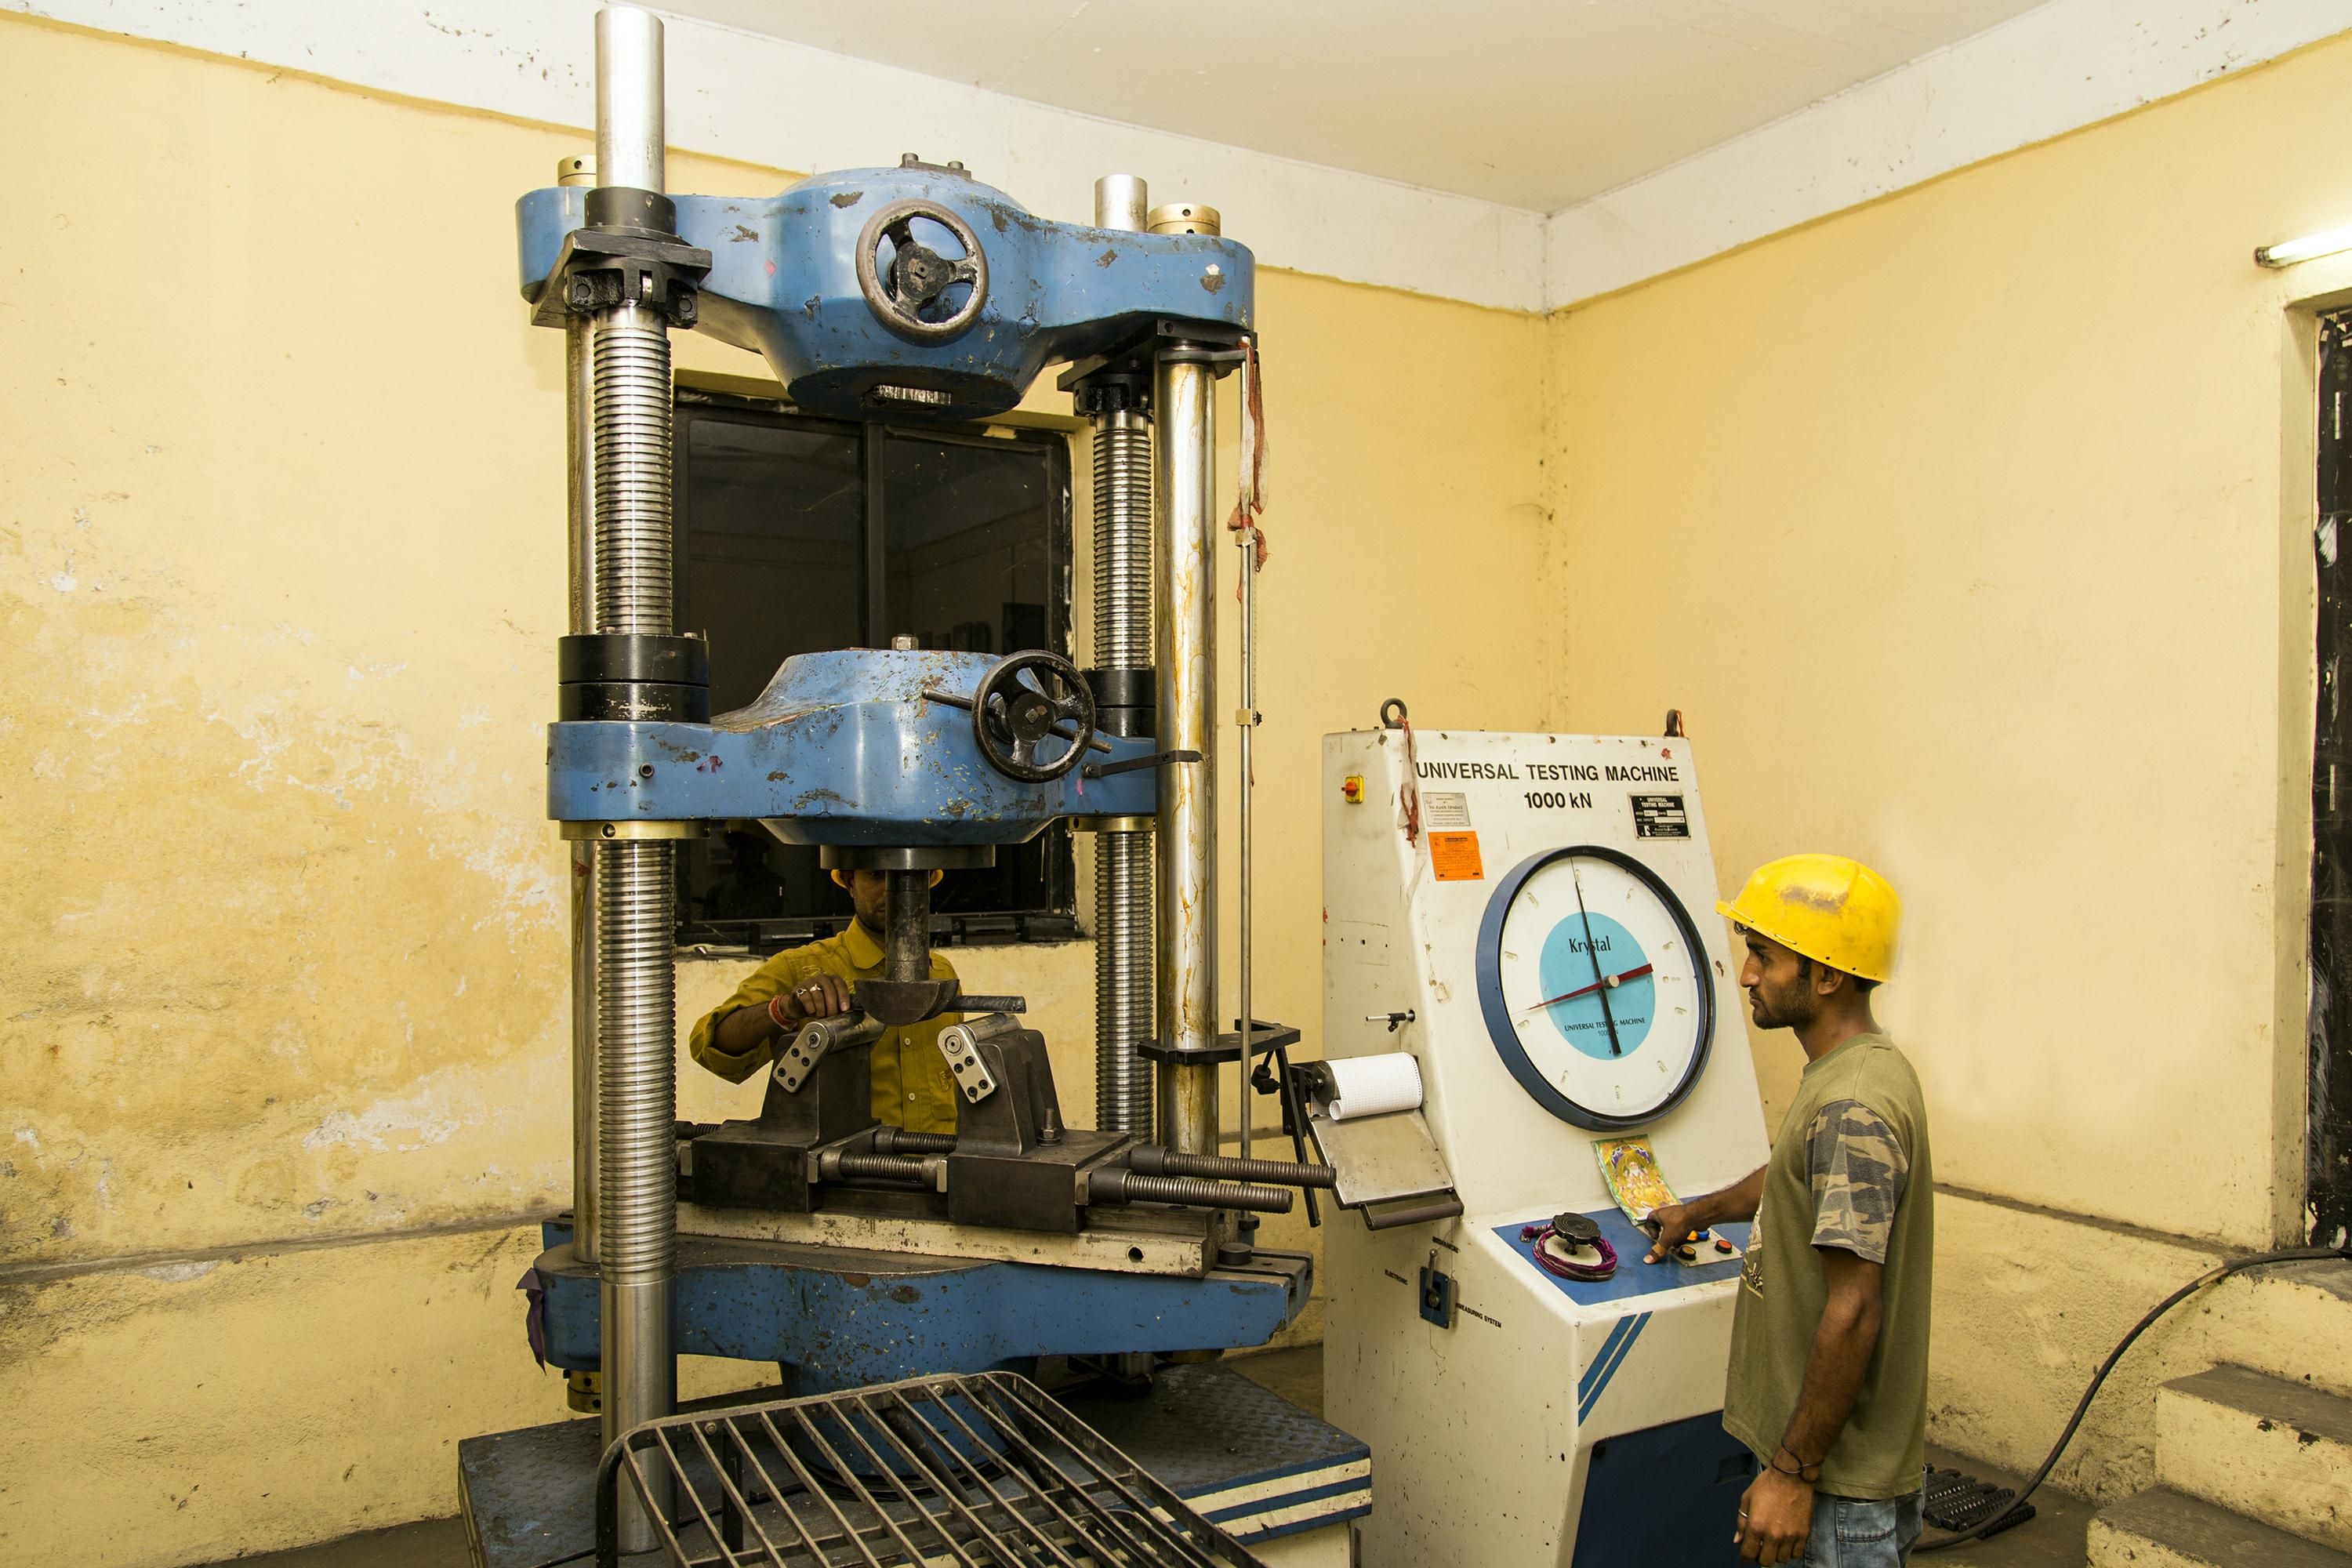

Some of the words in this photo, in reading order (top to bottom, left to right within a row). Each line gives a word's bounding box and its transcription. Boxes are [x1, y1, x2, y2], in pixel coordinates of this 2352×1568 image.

[1416, 761, 1519, 780] UNIVERSAL
[1526, 764, 1599, 781] TESTING
[1605, 765, 1679, 782] MACHINE
[1524, 792, 1566, 809] 1000
[1569, 792, 1593, 809] kN
[1564, 1022, 1595, 1032] UNIVERSAL
[1620, 1017, 1646, 1026] MACHINE
[1385, 1269, 1409, 1286] ELECTRONIC
[1484, 1315, 1502, 1328] SYSTEM
